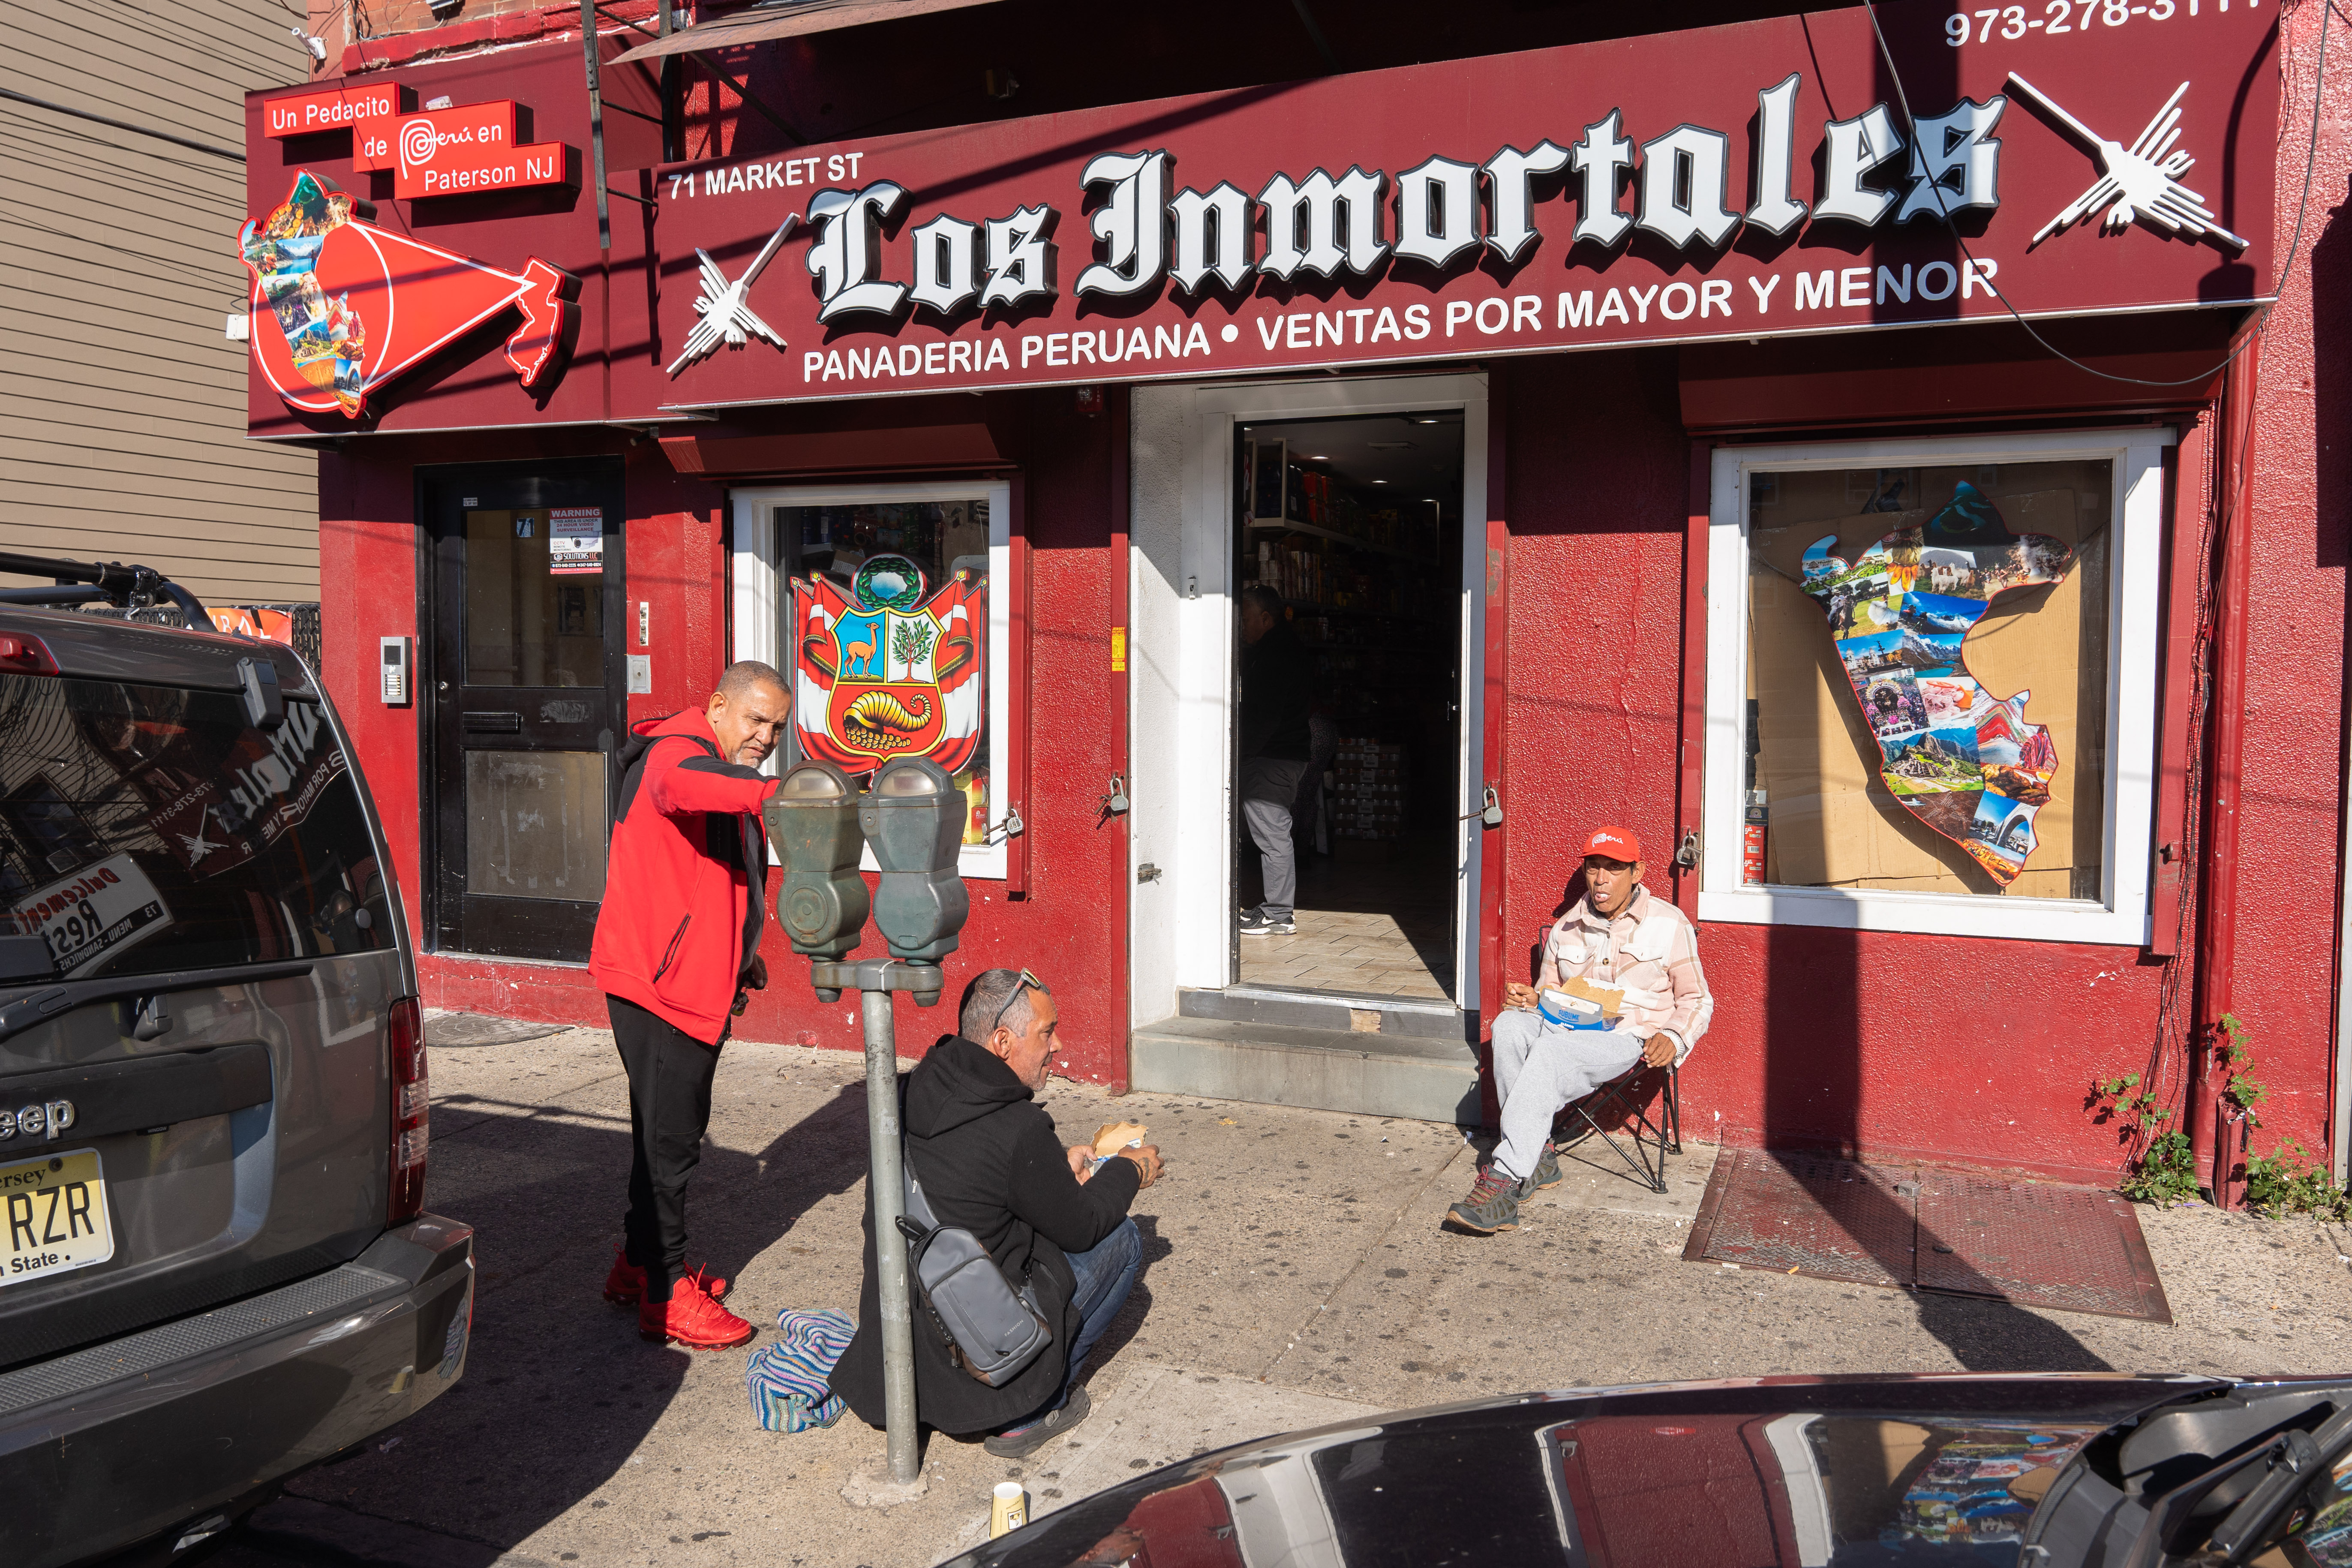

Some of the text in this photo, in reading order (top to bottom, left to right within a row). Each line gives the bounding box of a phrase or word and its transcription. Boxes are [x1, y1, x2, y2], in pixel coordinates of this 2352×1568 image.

[1945, 0, 2258, 47] 973-278-31
[273, 98, 389, 129] Un Pedacito
[364, 119, 502, 180] de Perú en
[425, 156, 553, 191] Paterson NJ
[668, 152, 864, 199] 71 MARKET ST
[1074, 73, 2008, 299] Inmortales
[805, 179, 1054, 324] Los
[1256, 258, 1998, 351] VENTAS POR MAYOR Y MENOR
[804, 322, 1211, 383] PANADERIA PERUANA
[518, 518, 535, 537] 71
[551, 509, 600, 517] WARNING
[1592, 833, 1623, 847] Perú
[1558, 1009, 1580, 1021] SUBLIME
[7, 1181, 95, 1252] RZR
[11, 1252, 59, 1274] State
[1004, 1319, 1024, 1337] FASHION
